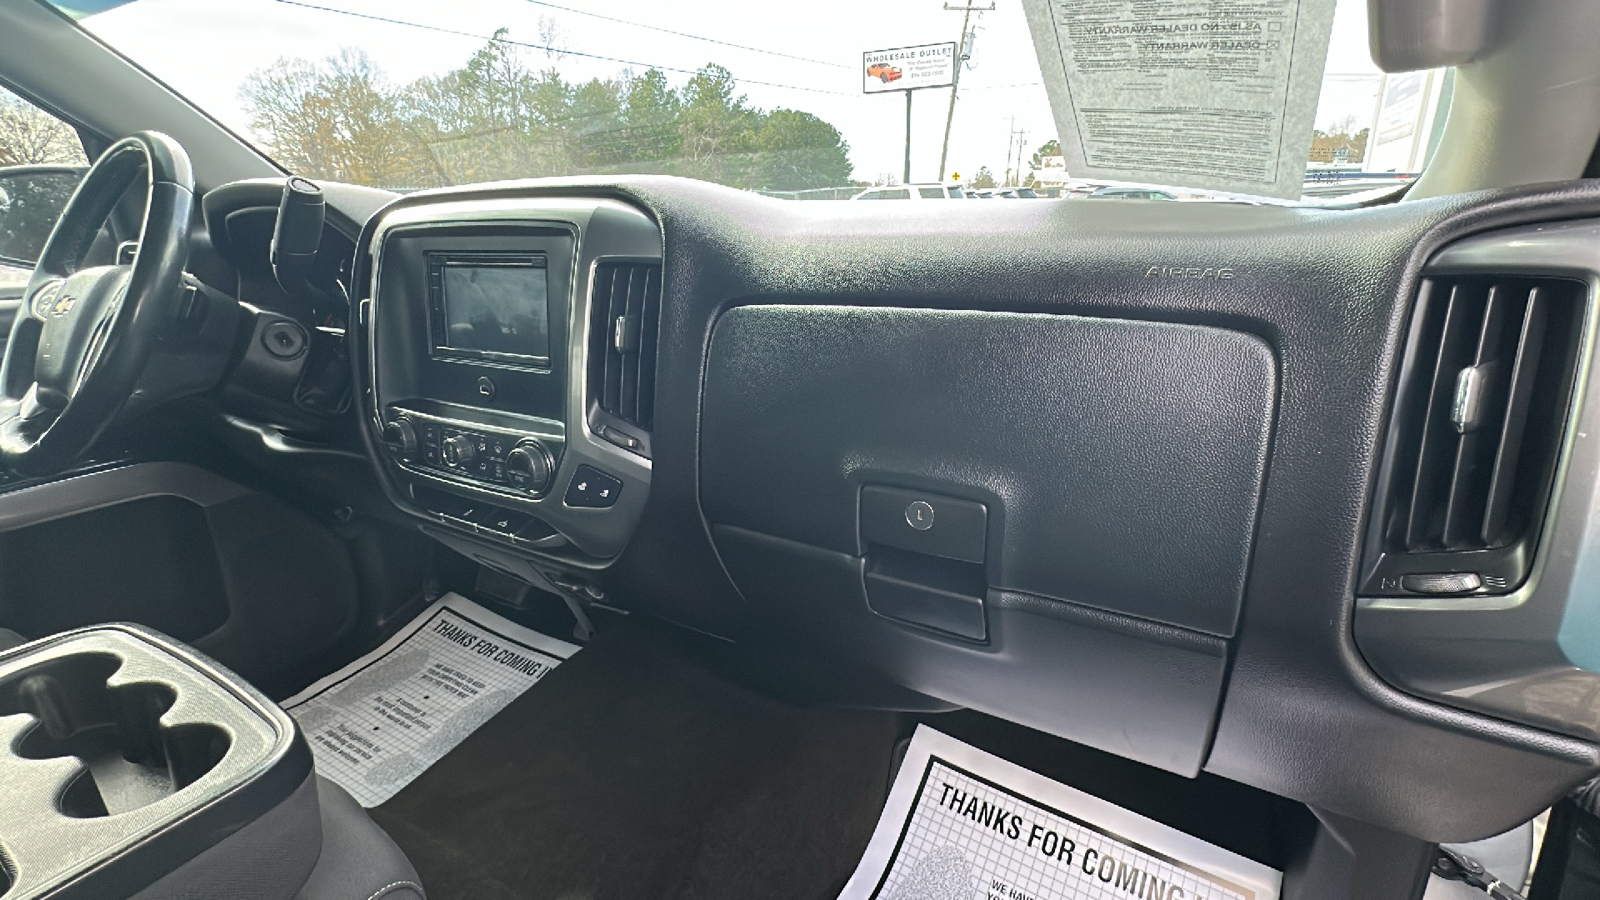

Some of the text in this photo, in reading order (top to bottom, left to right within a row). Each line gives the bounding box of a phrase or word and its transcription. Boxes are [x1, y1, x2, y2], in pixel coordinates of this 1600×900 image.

[866, 52, 916, 62] WHOLESALE
[920, 48, 952, 58] OUTLET
[1144, 266, 1234, 280] AIRBAG
[433, 619, 478, 648] THANKS
[470, 640, 498, 658] FOR
[494, 650, 542, 676] COMING
[940, 782, 1184, 900] THANKS FOR COMING
[992, 880, 1007, 895] WE
